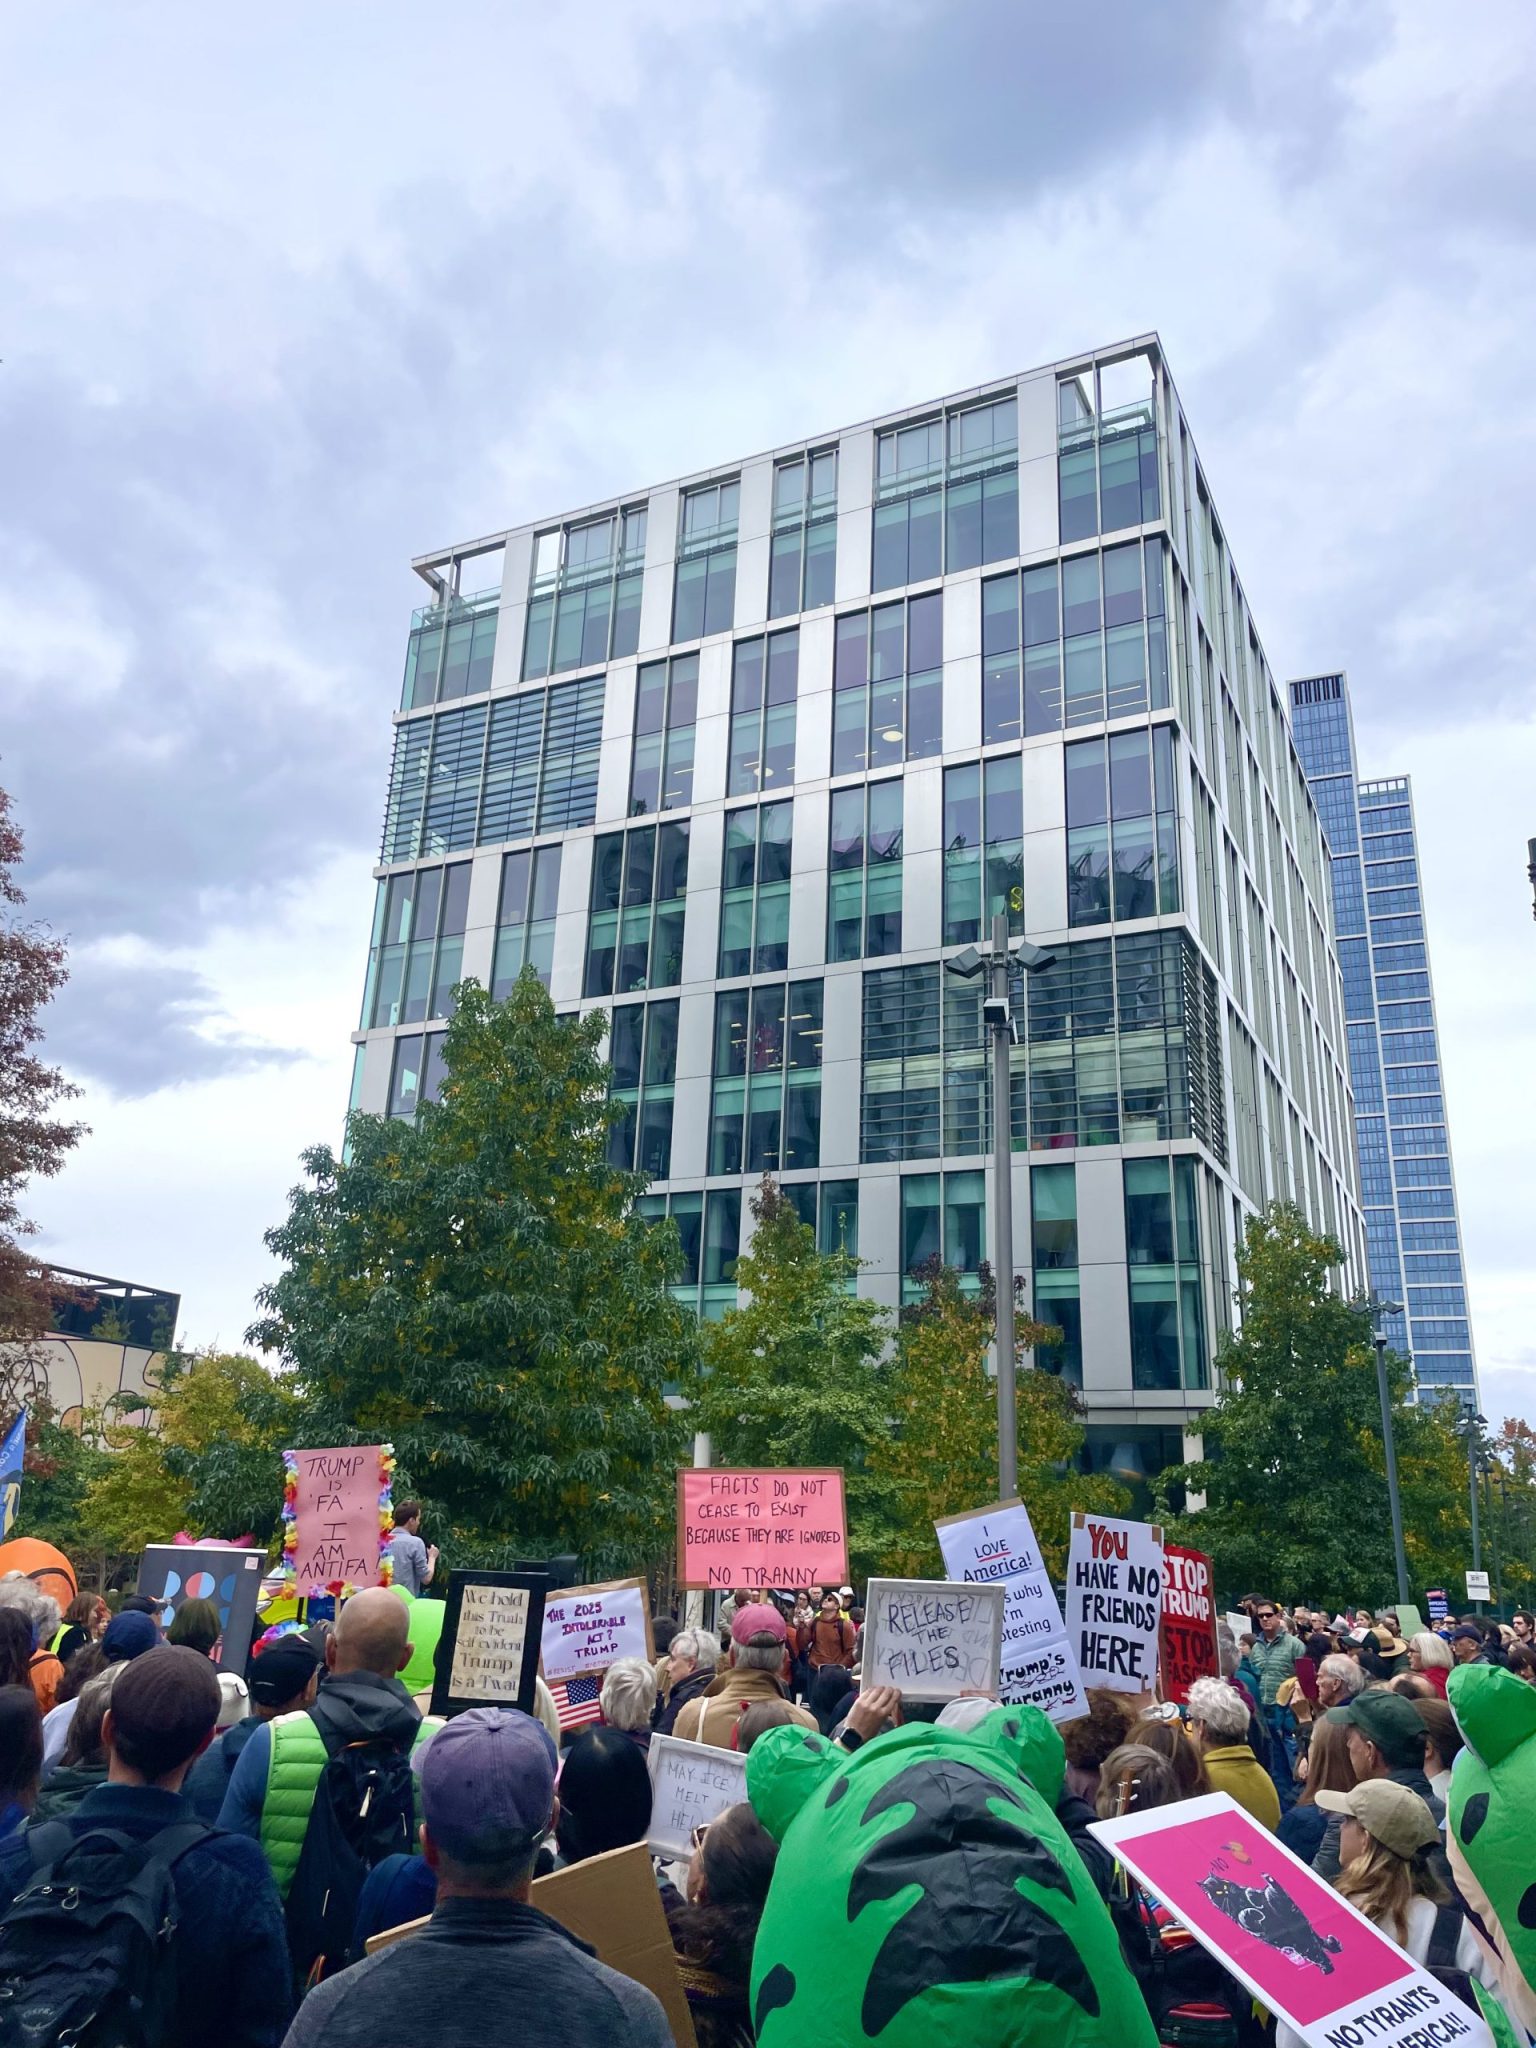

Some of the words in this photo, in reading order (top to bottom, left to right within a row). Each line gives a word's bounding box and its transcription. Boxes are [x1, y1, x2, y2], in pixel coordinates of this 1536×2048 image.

[305, 1456, 364, 1478] TRUMP
[329, 1480, 342, 1491] IS
[711, 1476, 759, 1495] FACTS
[774, 1480, 789, 1496] DO
[801, 1480, 827, 1496] NOT
[698, 1504, 739, 1519] CEASE
[745, 1502, 760, 1517] TO
[771, 1501, 808, 1518] EXIST
[321, 1522, 347, 1541] I
[687, 1527, 741, 1545] BECAUSE
[745, 1528, 771, 1544] THEY
[775, 1529, 795, 1544] ARE
[800, 1531, 841, 1544] IGNORED
[983, 1525, 989, 1537] I
[974, 1539, 1009, 1559] LOVE
[1088, 1524, 1128, 1560] YOU
[313, 1544, 345, 1561] AM
[709, 1567, 731, 1585] NO
[742, 1567, 818, 1586] TYRANNY
[964, 1551, 1032, 1582] America!
[1162, 1553, 1208, 1594] STOP
[1076, 1562, 1119, 1590] HAVE
[1128, 1565, 1160, 1598] NO
[465, 1589, 487, 1604] We
[491, 1591, 523, 1606] hold
[1013, 1584, 1043, 1600] why
[546, 1608, 565, 1623] THE
[574, 1602, 602, 1617] 2025
[1082, 1594, 1156, 1632] FRIENDS
[1161, 1588, 1210, 1622] TRUMP
[463, 1610, 484, 1622] this
[562, 1616, 626, 1636] INTOLERABLE
[888, 1599, 971, 1634] RELEASE
[490, 1625, 504, 1636] be
[912, 1626, 949, 1644] THE
[1000, 1619, 1051, 1642] otesting
[574, 1643, 618, 1658] TRUMP
[1080, 1630, 1149, 1680] HERE.
[1164, 1626, 1213, 1666] STOP
[460, 1653, 513, 1673] Trump
[888, 1645, 960, 1680] FILES
[466, 1679, 475, 1688] a
[480, 1675, 516, 1690] Twat
[668, 1761, 696, 1782] MAY
[675, 1785, 709, 1804] MELT
[1324, 2025, 1364, 2048] NO
[1352, 1985, 1440, 2038] TYRANTS
